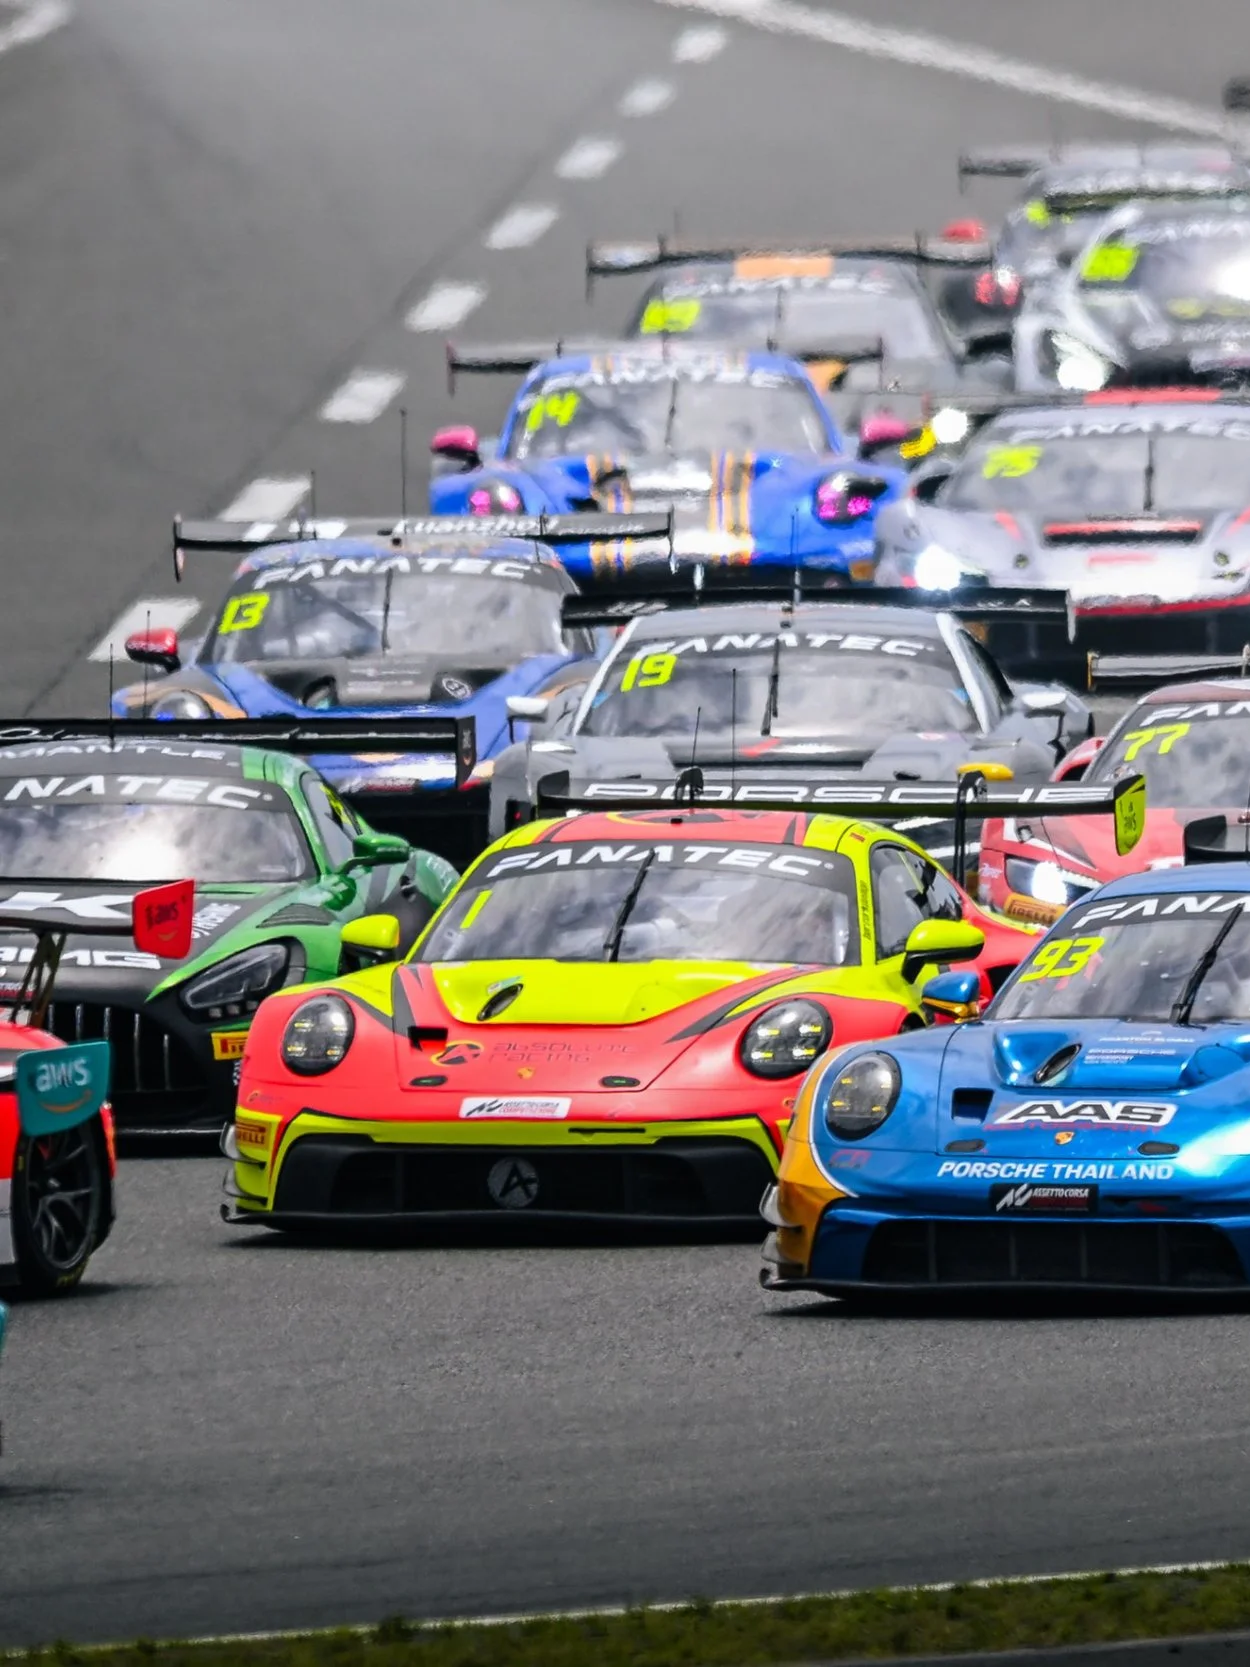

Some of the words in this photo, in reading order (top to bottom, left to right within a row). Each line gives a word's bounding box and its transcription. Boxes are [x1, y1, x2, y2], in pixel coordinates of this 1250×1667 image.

[254, 556, 531, 589] FANATEC
[218, 592, 270, 634] 13
[632, 632, 929, 658] FANATEC
[621, 653, 677, 692] 19
[1122, 723, 1191, 761] 77
[486, 845, 823, 877] FANATEC
[461, 890, 492, 929] 1
[1019, 936, 1106, 983] 93
[35, 1057, 92, 1094] aws
[996, 1100, 1178, 1126] AAS
[937, 1161, 1047, 1179] PORSCHE
[1052, 1163, 1175, 1180] THAILAND
[1033, 1187, 1064, 1198] ASSETTO
[1063, 1187, 1090, 1199] CORSA
